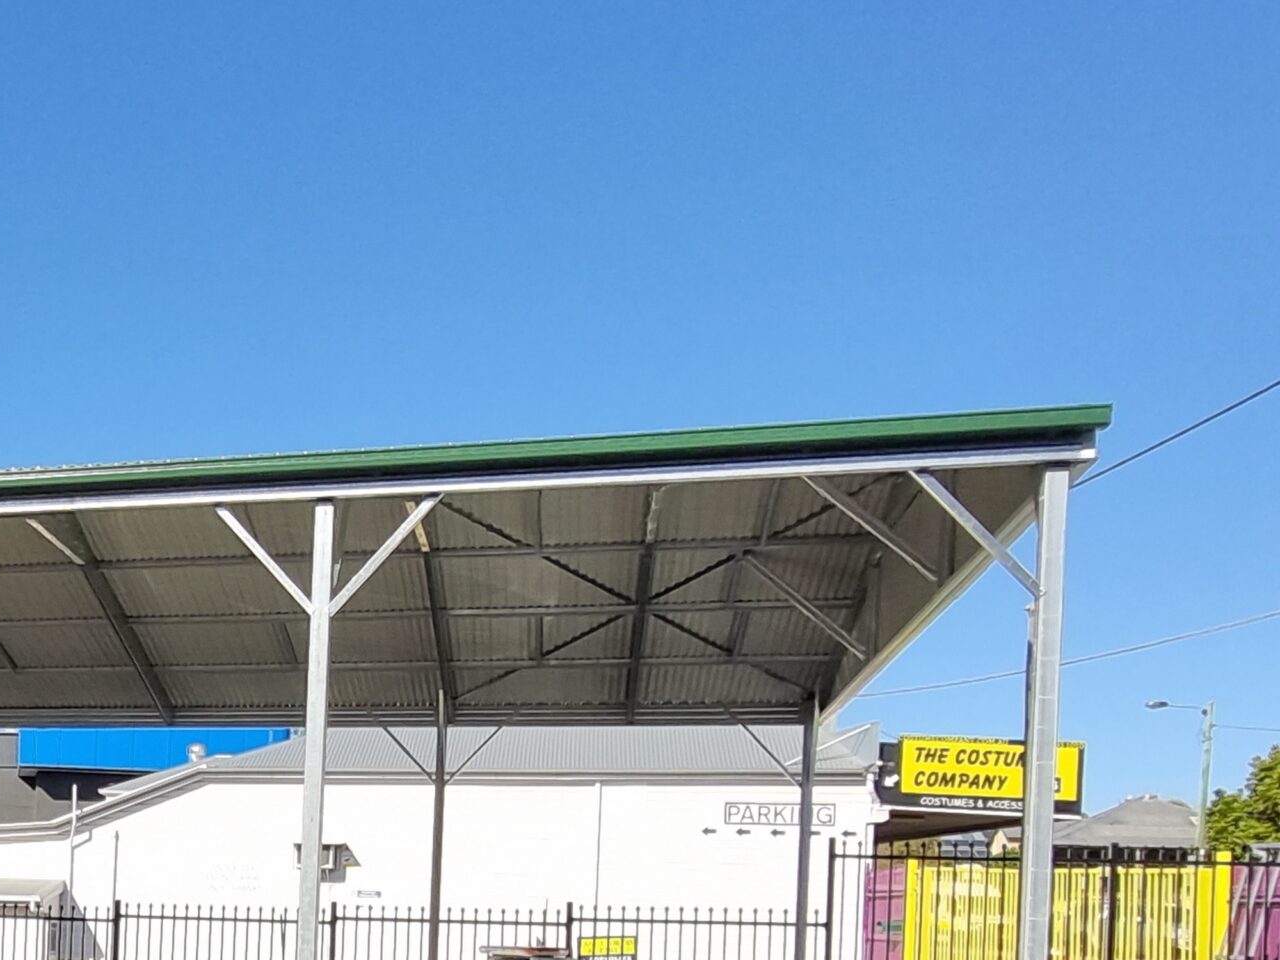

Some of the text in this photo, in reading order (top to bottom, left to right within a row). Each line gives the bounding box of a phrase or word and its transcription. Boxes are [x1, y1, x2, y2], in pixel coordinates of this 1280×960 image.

[914, 747, 950, 764] THE
[914, 771, 1008, 791] COMPANY
[919, 796, 975, 808] COSTUMES
[727, 804, 833, 825] PARKIG
